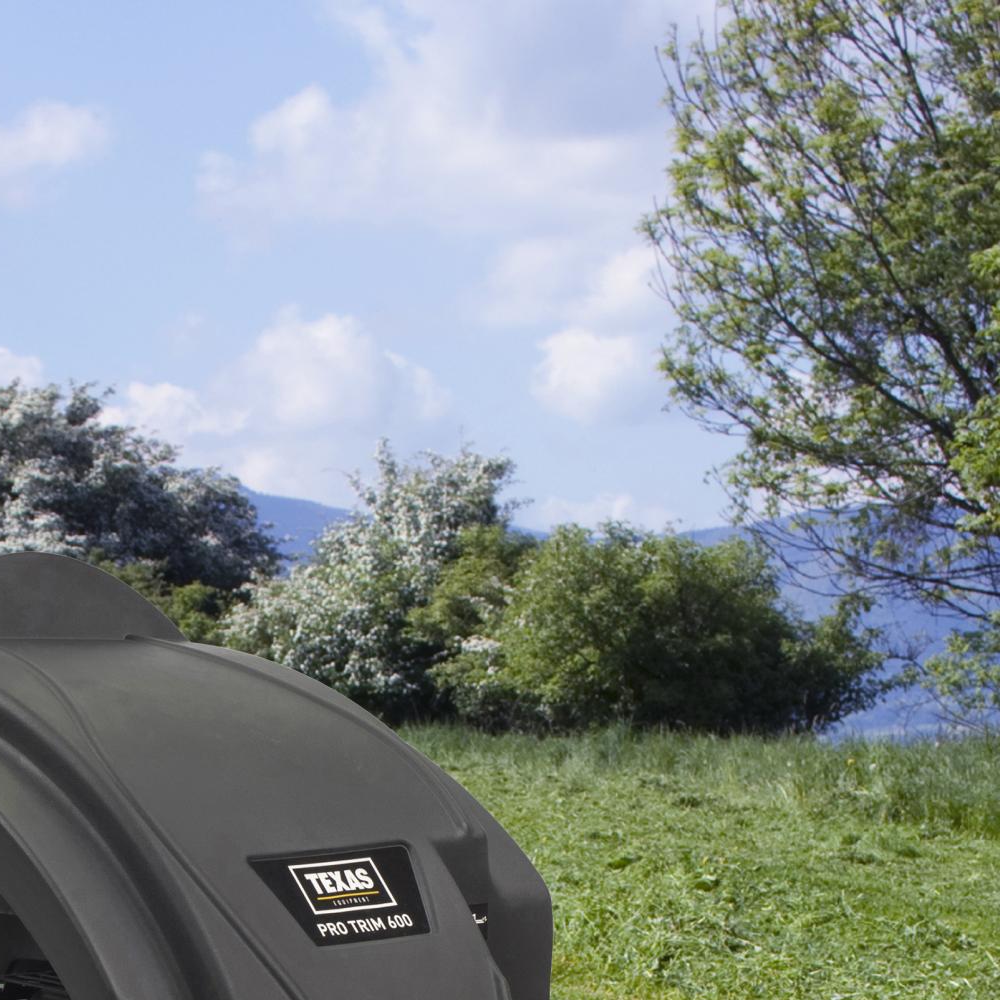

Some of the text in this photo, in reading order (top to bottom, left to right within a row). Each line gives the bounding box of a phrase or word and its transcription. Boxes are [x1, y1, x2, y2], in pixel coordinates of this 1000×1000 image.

[304, 868, 374, 895] TEXAS
[317, 914, 413, 937] PRO TRIM 600
